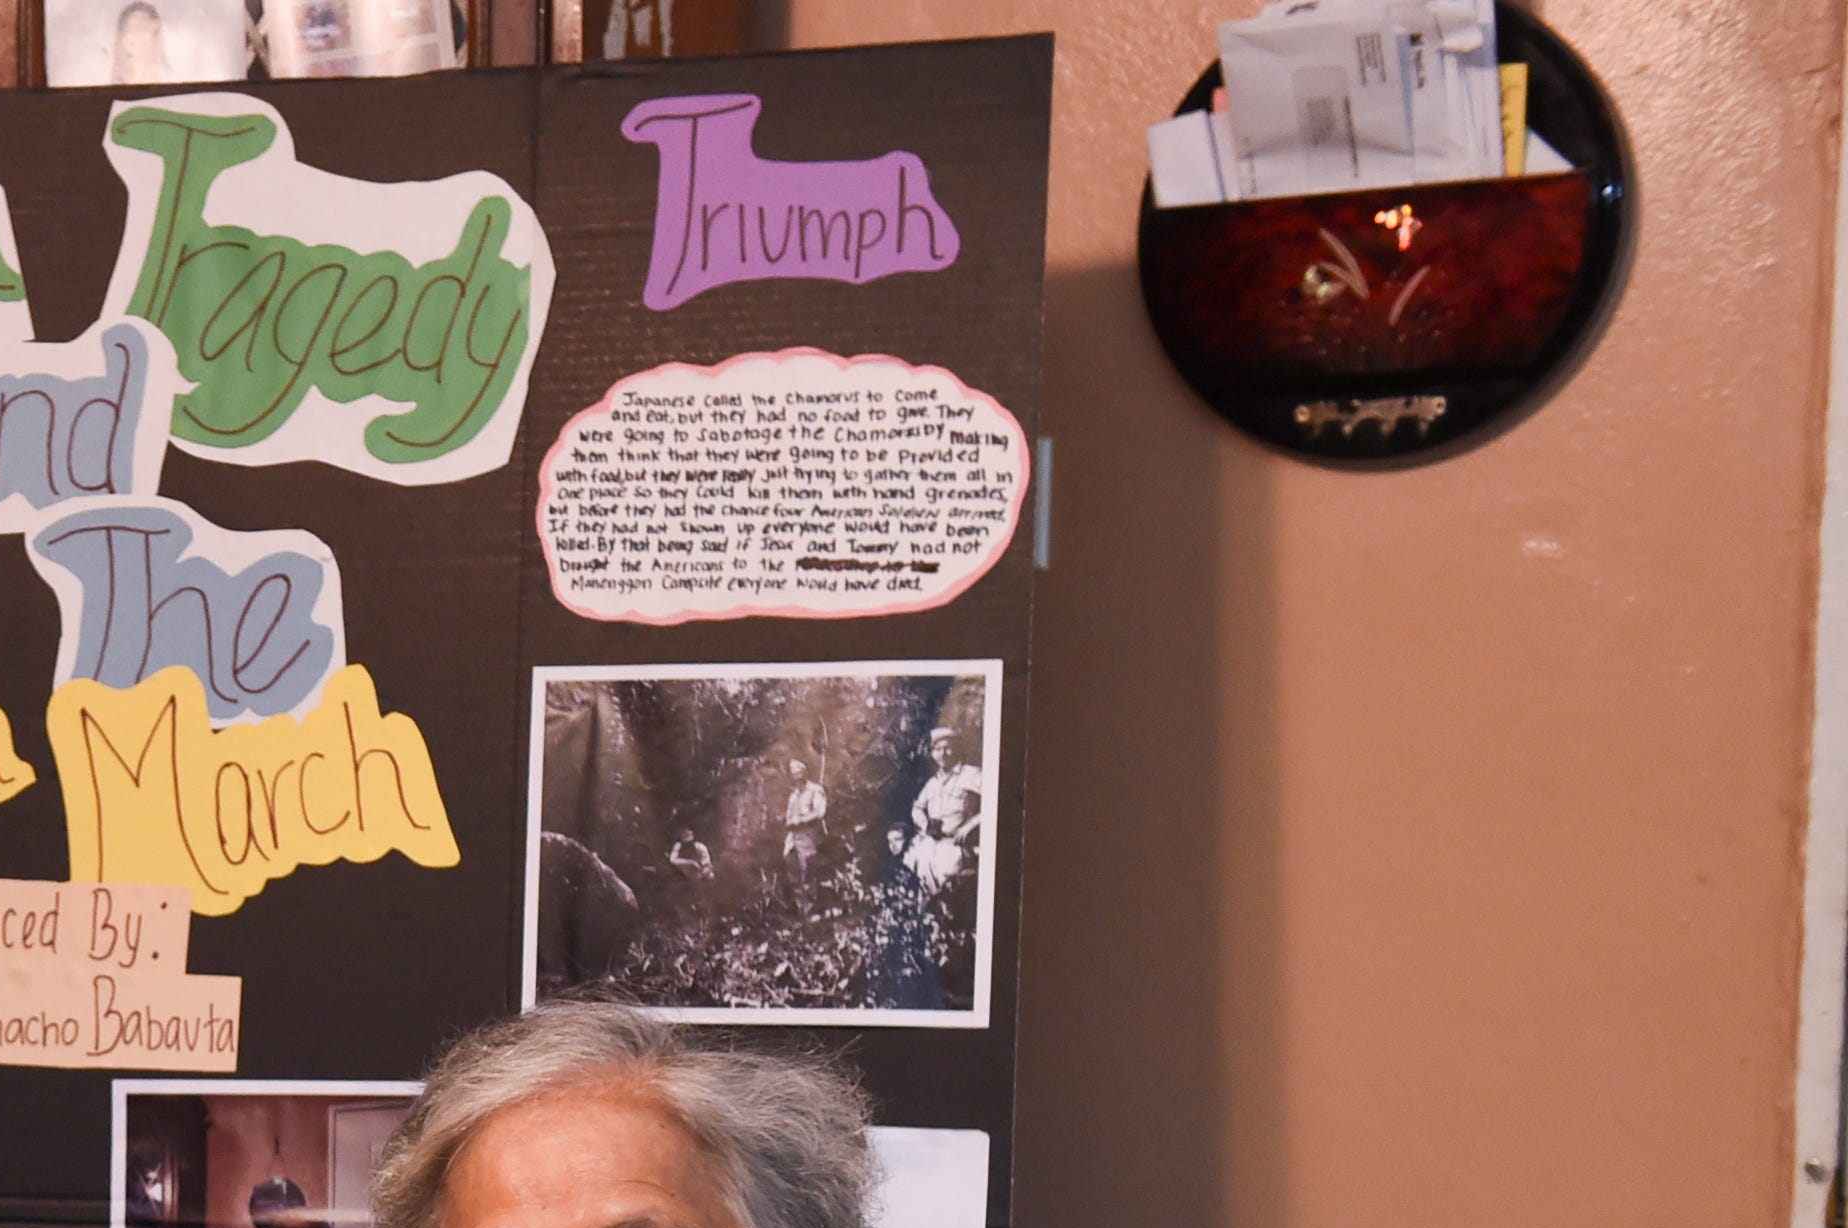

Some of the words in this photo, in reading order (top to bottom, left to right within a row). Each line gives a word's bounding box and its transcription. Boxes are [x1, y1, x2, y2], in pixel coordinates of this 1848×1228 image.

[634, 99, 945, 297] Triumph
[115, 115, 523, 448] Tragedy
[622, 391, 695, 407] Japanese
[752, 393, 775, 406] the
[867, 389, 884, 402] to
[611, 409, 640, 423] and
[712, 410, 746, 424] they
[757, 407, 786, 422] had
[798, 408, 817, 422] no
[824, 409, 860, 422] food
[869, 407, 886, 421] to
[937, 404, 975, 422] They
[624, 428, 665, 446] going
[674, 429, 689, 442] to
[789, 424, 825, 441] the
[950, 430, 1010, 451] making
[571, 447, 608, 463] them
[618, 448, 660, 462] think
[667, 448, 700, 462] that
[706, 448, 740, 464] they
[745, 449, 781, 462] were
[790, 446, 834, 464] going
[841, 447, 859, 461] to
[866, 448, 889, 461] be
[555, 469, 587, 482] with
[653, 470, 681, 484] they
[761, 468, 788, 483] just
[795, 469, 836, 485] trying
[844, 469, 859, 482] to
[864, 469, 911, 485] gather
[919, 469, 957, 482] them
[967, 468, 986, 482] all
[996, 471, 1013, 484] in
[589, 486, 628, 502] place
[659, 486, 689, 503] they
[748, 486, 770, 500] kill
[779, 486, 823, 500] them
[833, 487, 867, 500] with
[873, 486, 916, 500] hand
[549, 504, 569, 516] but
[579, 504, 619, 517] before
[625, 503, 656, 518] they
[664, 503, 687, 517] had
[693, 503, 716, 517] the
[773, 504, 806, 518] four
[811, 503, 874, 518] American
[548, 520, 570, 534] If
[576, 520, 607, 535] they
[612, 521, 639, 535] had
[646, 523, 669, 535] not
[737, 522, 755, 536] up
[762, 521, 835, 537] everyone
[899, 520, 937, 534] have
[946, 523, 990, 538] been
[597, 537, 615, 555] By
[622, 537, 650, 552] that
[657, 538, 694, 555] being
[700, 538, 729, 552] said
[736, 538, 752, 551] if
[806, 539, 837, 552] and
[847, 538, 899, 555] Tommy
[910, 538, 946, 553] had
[952, 540, 982, 554] not
[620, 558, 642, 572] the
[732, 557, 747, 571] to
[761, 557, 785, 571] the
[570, 574, 653, 594] Manenggon
[727, 576, 788, 594] everyone
[844, 576, 880, 590] have
[48, 525, 311, 705] The
[81, 693, 432, 893] March
[89, 888, 171, 969] By:
